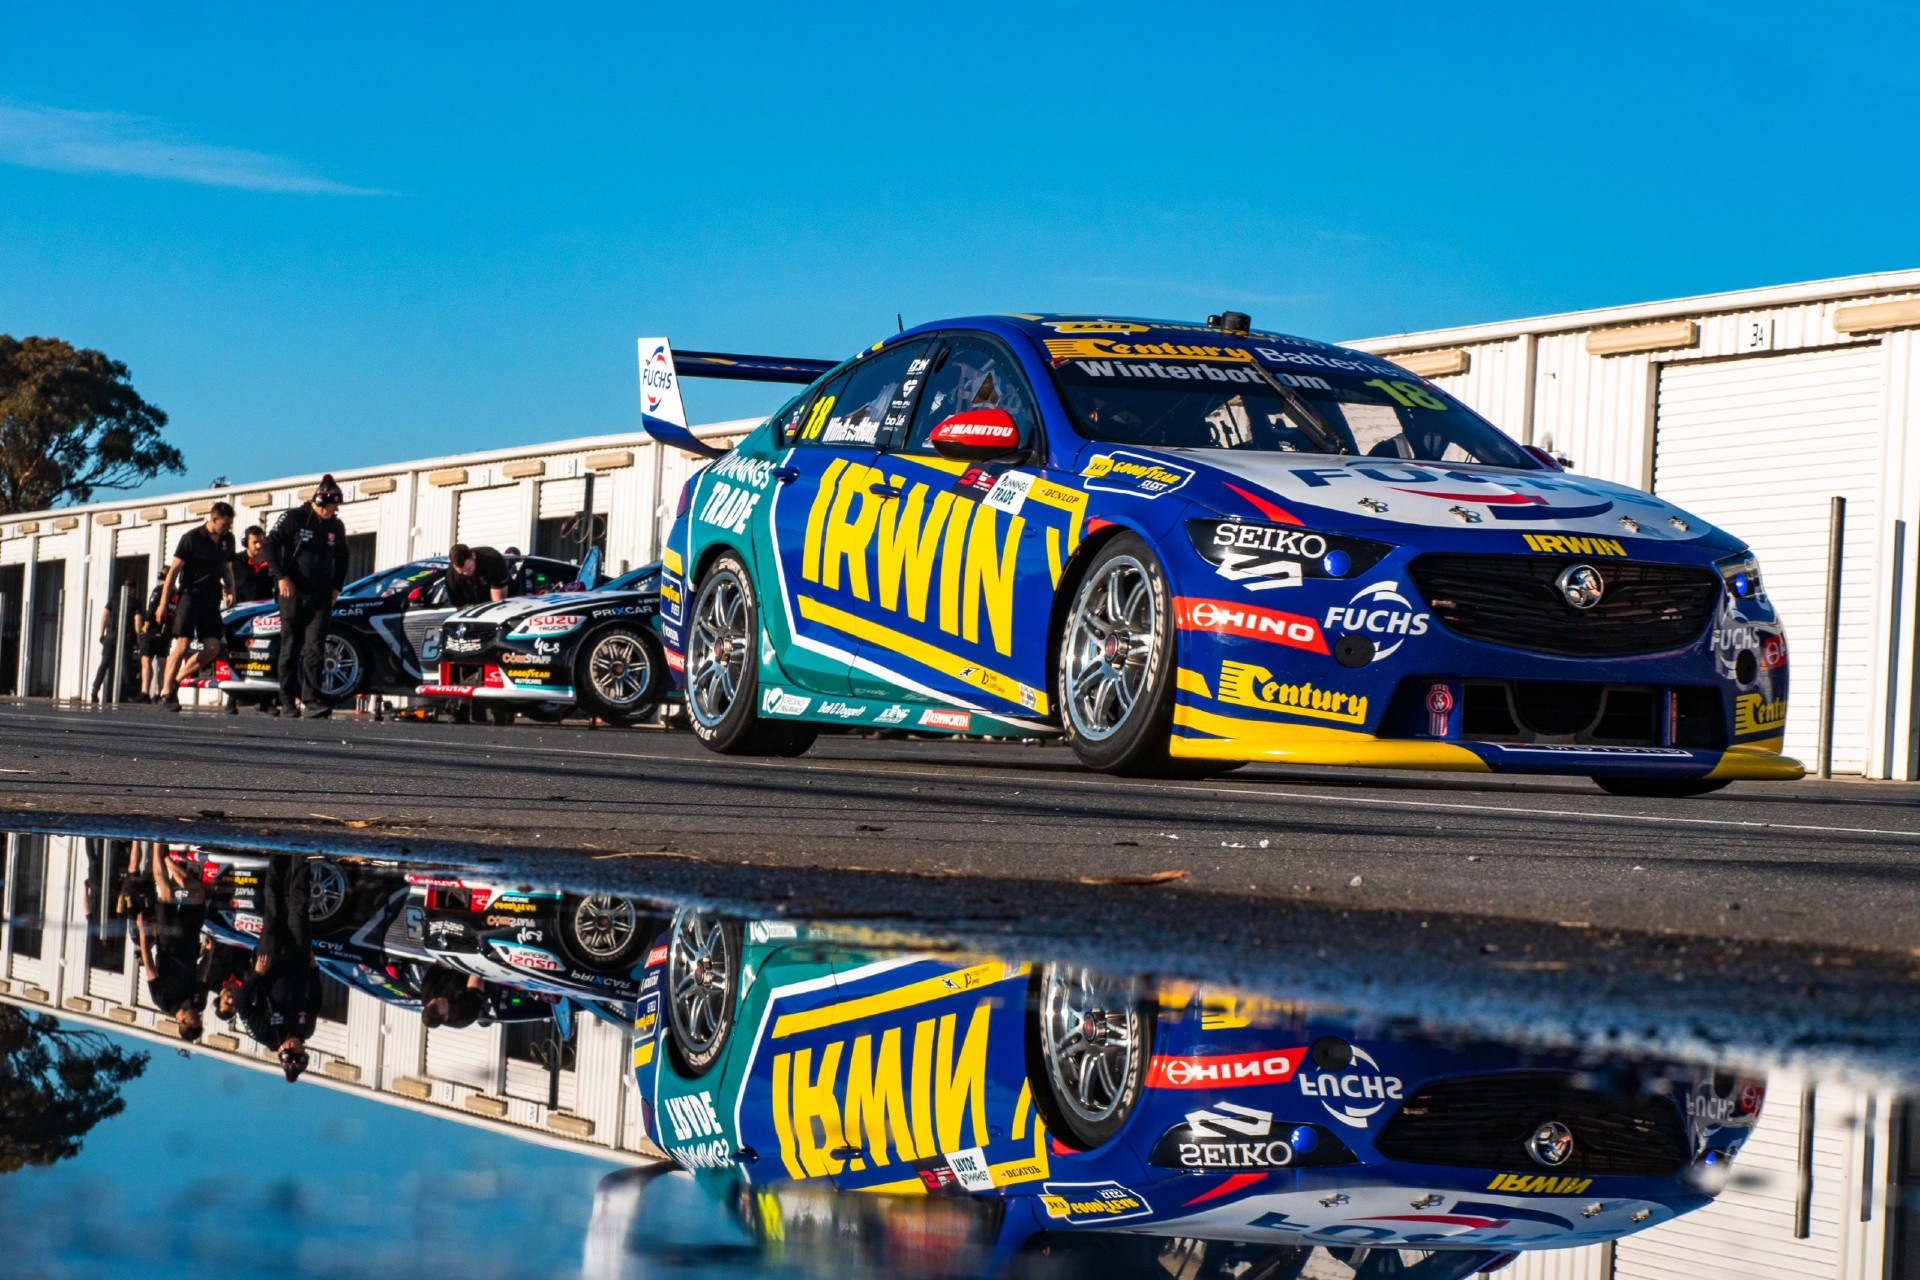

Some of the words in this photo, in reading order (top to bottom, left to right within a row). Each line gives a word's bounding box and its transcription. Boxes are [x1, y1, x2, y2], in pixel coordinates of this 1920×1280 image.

[1043, 338, 1255, 363] Century
[642, 367, 673, 390] FUCHS
[1075, 360, 1332, 391] Winterbotom
[1363, 379, 1448, 411] 18
[801, 396, 835, 440] 18
[950, 424, 1014, 438] MANITOU
[711, 452, 777, 490] BUNNINGS
[1112, 461, 1182, 485] GOODYEAR
[699, 481, 760, 535] TRADE
[991, 487, 1017, 506] TRADE
[1044, 488, 1080, 504] DUNLOP
[1213, 523, 1327, 559] SEIKO
[1523, 534, 1628, 557] IRWIN
[802, 457, 1026, 658] IRWIN
[252, 615, 281, 627] SUZ
[331, 608, 363, 617] XCAR
[529, 616, 579, 626] ISUZU
[592, 605, 653, 619] PRIXCAR
[1323, 606, 1430, 636] FUCHS
[1215, 609, 1314, 642] HINO
[1710, 626, 1760, 651] FUCHS
[507, 668, 551, 680] GOODYEAR
[1218, 659, 1368, 725] Century
[928, 711, 969, 728] KENWORTH
[1735, 693, 1786, 736] Centu
